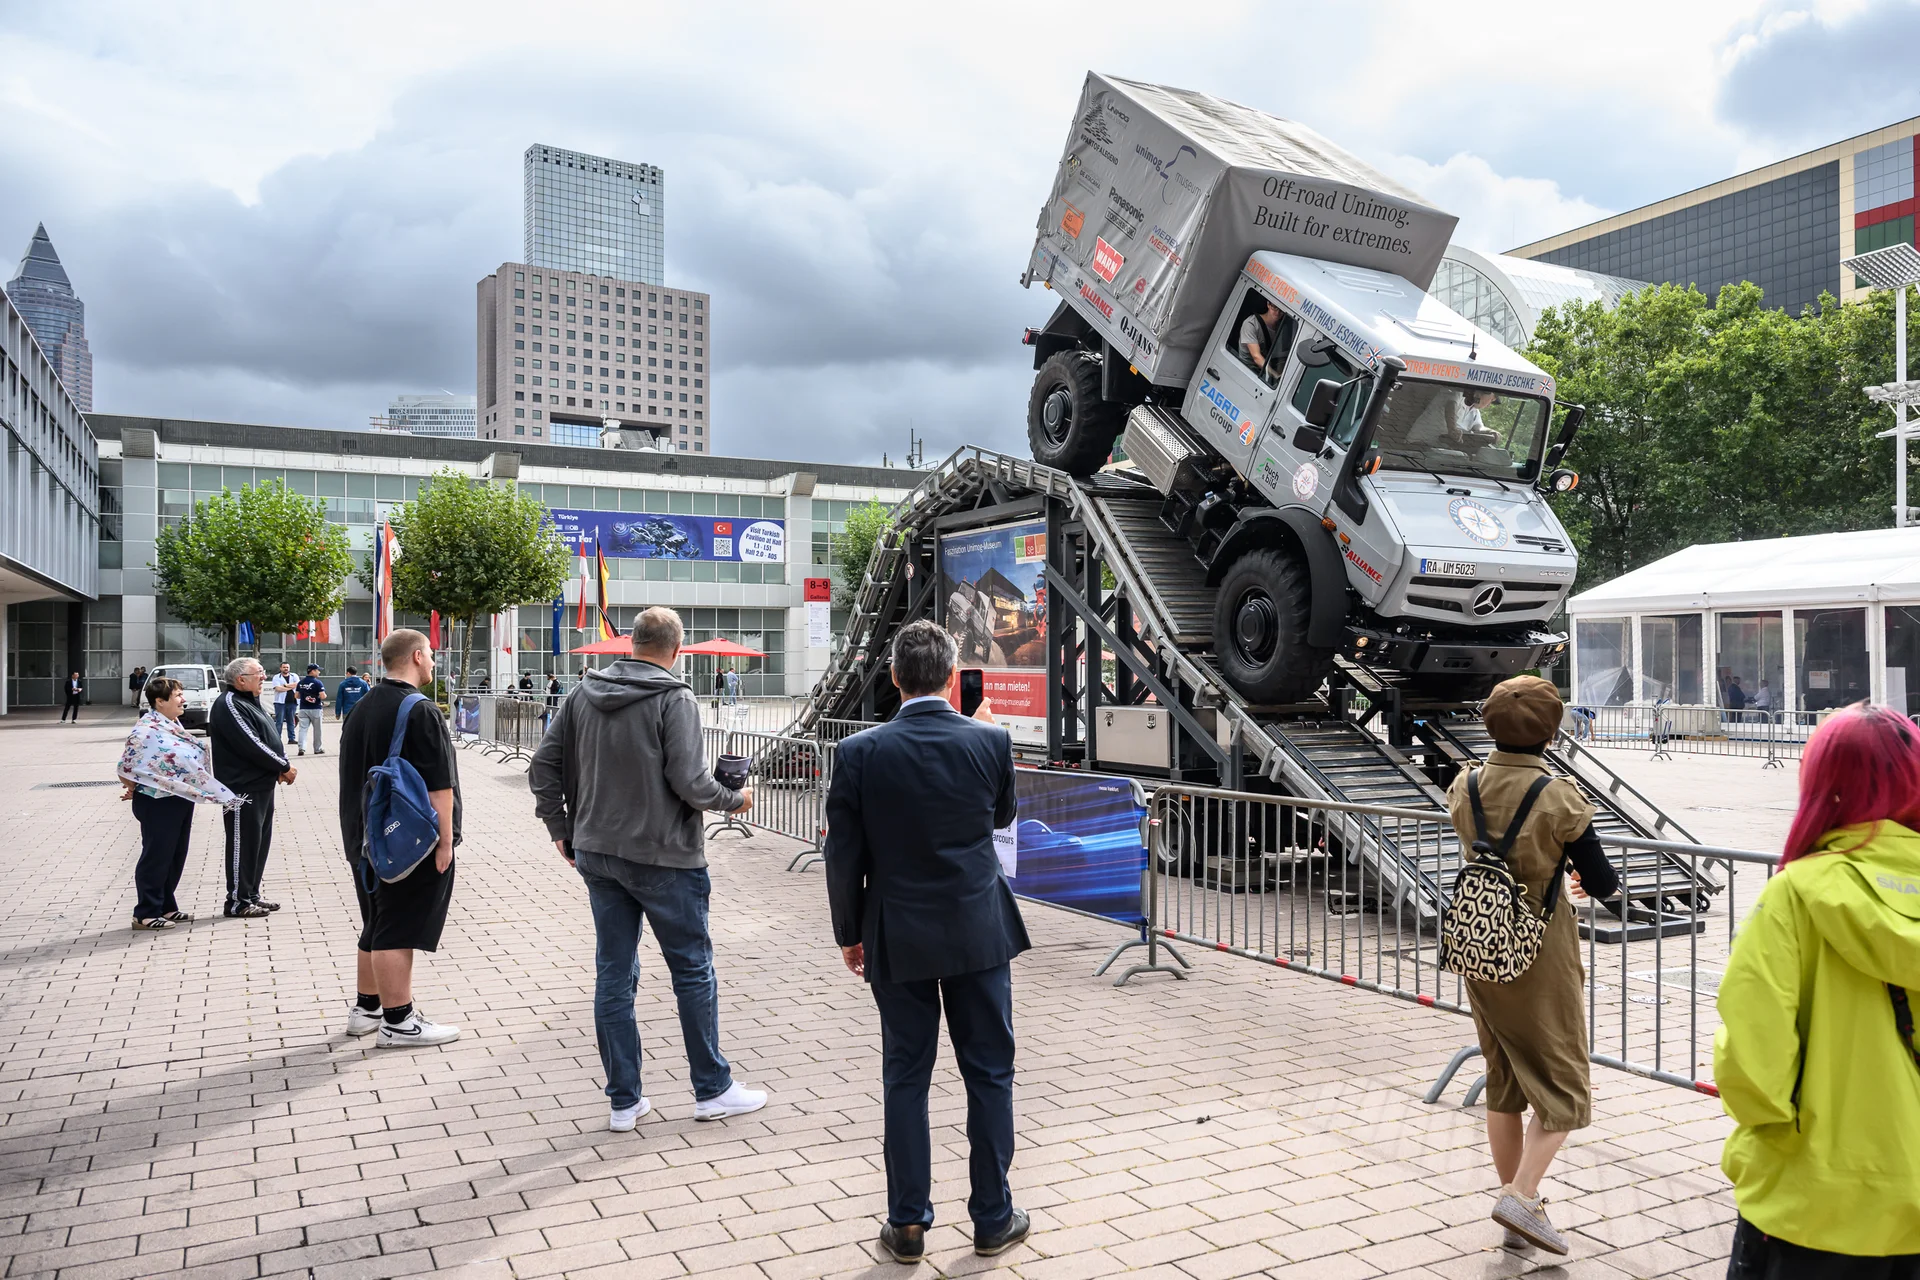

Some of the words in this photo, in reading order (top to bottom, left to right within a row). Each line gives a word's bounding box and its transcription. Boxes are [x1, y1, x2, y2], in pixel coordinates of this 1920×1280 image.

[1106, 104, 1130, 123] UNIMOG
[1135, 143, 1163, 172] unimog
[1175, 172, 1202, 197] museum
[1108, 186, 1145, 223] Panasonic
[1262, 176, 1338, 211] Off-road
[1342, 192, 1410, 229] Unimog.
[1152, 224, 1180, 251] MEREX
[1253, 205, 1300, 233] Built
[1302, 215, 1330, 239] for
[1332, 226, 1412, 255] extremes.
[1096, 249, 1118, 275] WARN
[1148, 234, 1182, 266] MERTEC
[1080, 283, 1114, 319] ALLIANCE
[1246, 258, 1275, 286] EXTREM
[1270, 276, 1299, 303] EVENTS
[1300, 298, 1336, 331] MATTHIAS
[1332, 323, 1368, 355] JESCHKE
[1432, 363, 1460, 379] EVENTS
[1467, 368, 1504, 385] MATTHIAS
[1504, 374, 1536, 390] JESCHKE
[1200, 379, 1240, 421] ZAGRO
[1210, 406, 1233, 434] Group
[1264, 463, 1280, 481] buch
[1264, 475, 1278, 490] bild
[745, 533, 765, 542] Pavilion
[750, 526, 762, 535] Visit
[762, 529, 780, 538] Turkish
[944, 544, 966, 556] Faszination
[967, 541, 1003, 553] Unimog-Museum
[1346, 550, 1383, 583] ALLIANCE
[1427, 561, 1437, 573] RA
[1443, 562, 1455, 574] UM
[1455, 563, 1476, 575] 5023
[994, 682, 1006, 691] man
[1007, 680, 1030, 692] mieten!
[992, 834, 1014, 845] arcours
